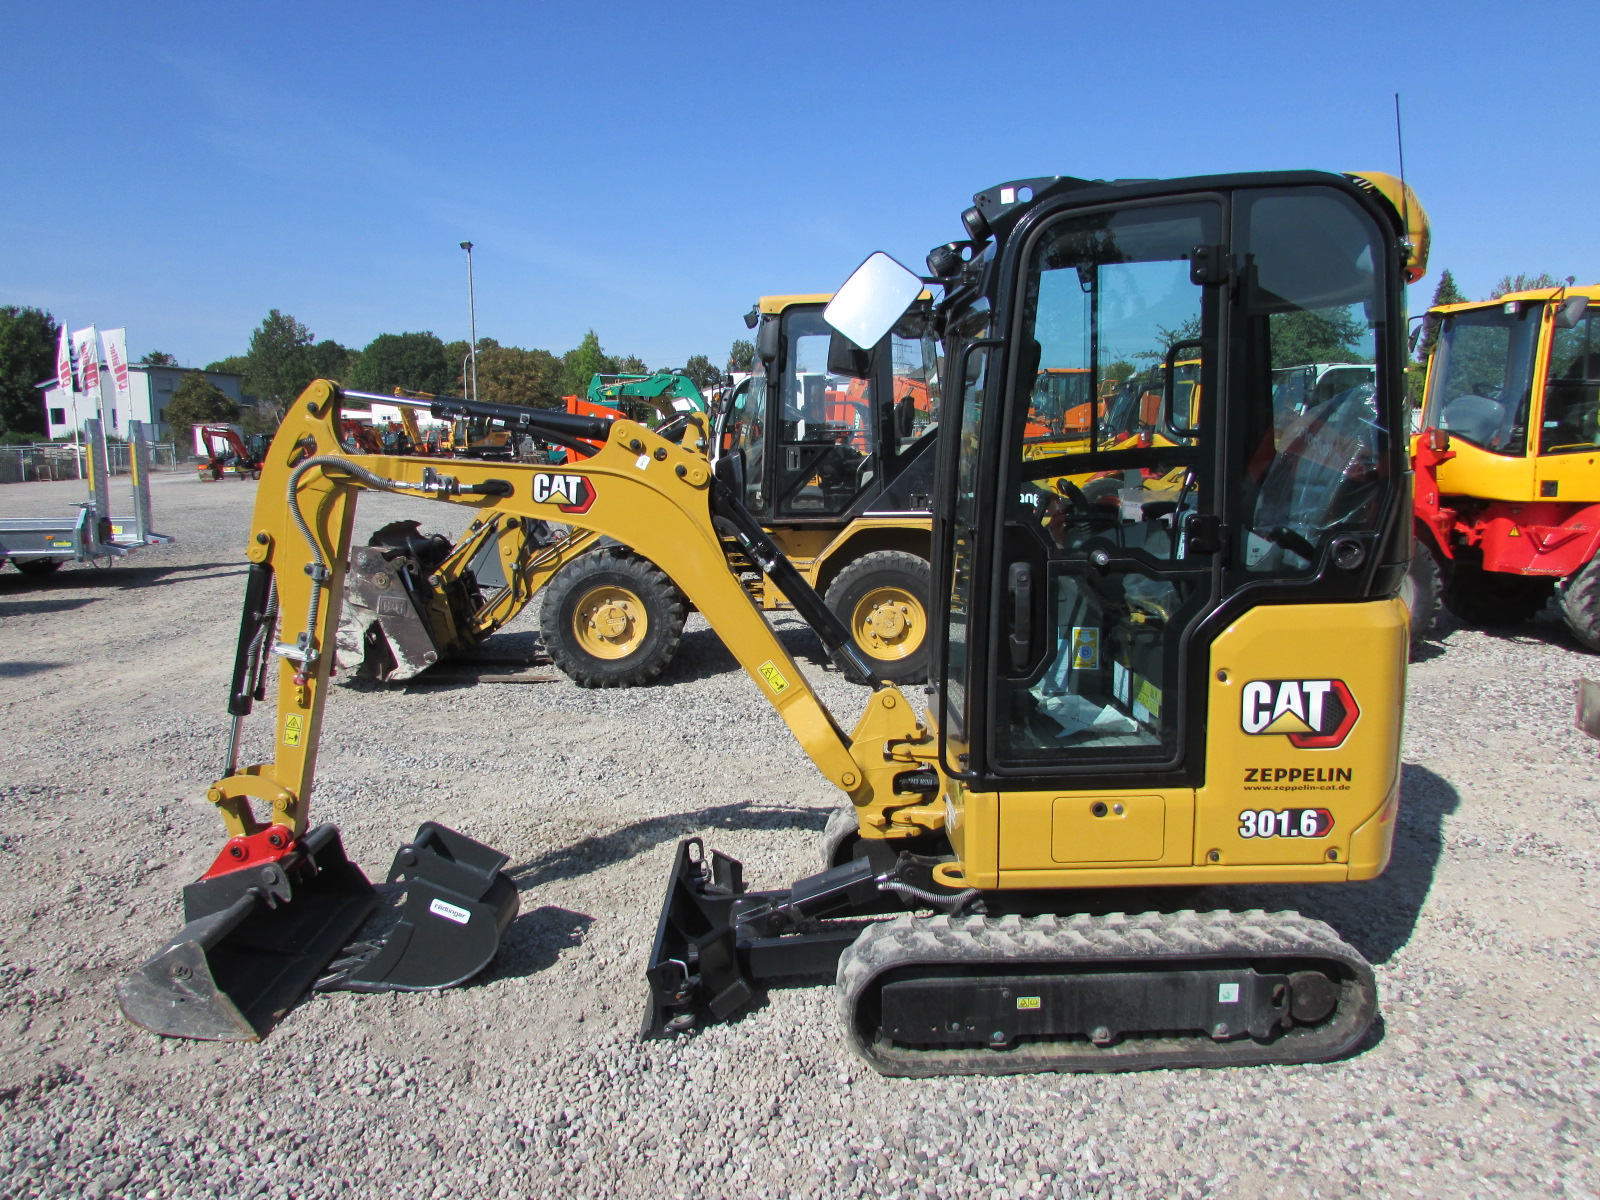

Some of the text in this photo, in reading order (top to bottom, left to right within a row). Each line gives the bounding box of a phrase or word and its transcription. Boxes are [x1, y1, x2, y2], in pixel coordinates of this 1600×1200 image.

[533, 473, 582, 505] CAT
[1242, 680, 1331, 734] CAT
[1243, 767, 1353, 783] ZEPPELIN
[1243, 784, 1351, 792] www.zeppelin-cat.de
[1239, 808, 1318, 838] 301.6
